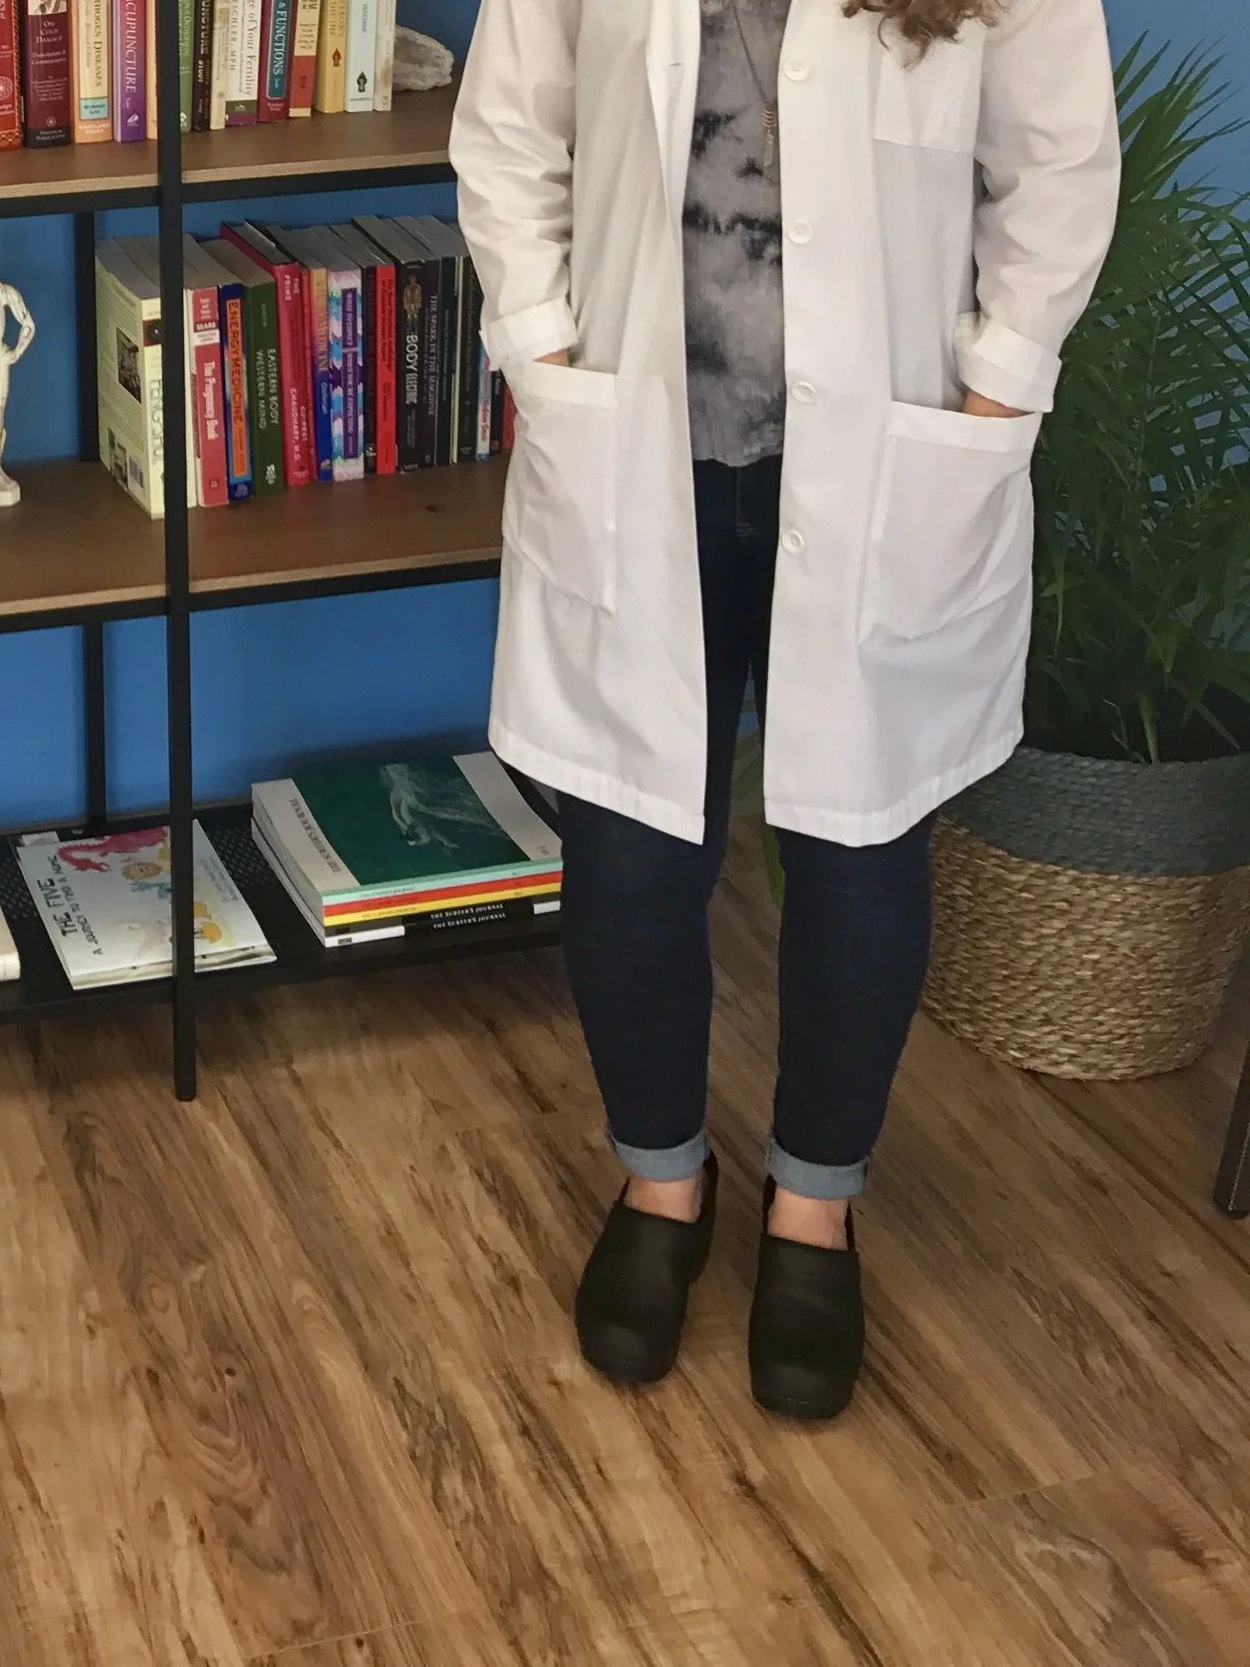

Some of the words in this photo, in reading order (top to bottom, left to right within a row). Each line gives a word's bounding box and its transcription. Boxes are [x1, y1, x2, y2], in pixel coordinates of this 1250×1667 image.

[248, 14, 257, 23] of
[246, 24, 257, 50] Your
[273, 9, 288, 75] FUNCTIONS
[93, 41, 103, 87] DISEASES
[229, 50, 237, 71] MPH
[245, 55, 256, 96] Fertility
[284, 275, 292, 301] PRIME
[229, 301, 241, 354] ENERGY
[203, 361, 216, 375] The
[406, 335, 419, 372] BODY
[256, 350, 266, 396] WESTERN
[268, 349, 277, 393] EASTERN
[230, 356, 243, 423] MEDICINE
[405, 373, 418, 405] ELECTRIC
[258, 399, 267, 430] MIND
[269, 395, 279, 424] BODY
[37, 877, 64, 909] FIVE
[52, 911, 78, 937] THE
[433, 921, 446, 929] THE
[478, 912, 506, 923] JOURNAL
[475, 903, 504, 915] JOURNAL
